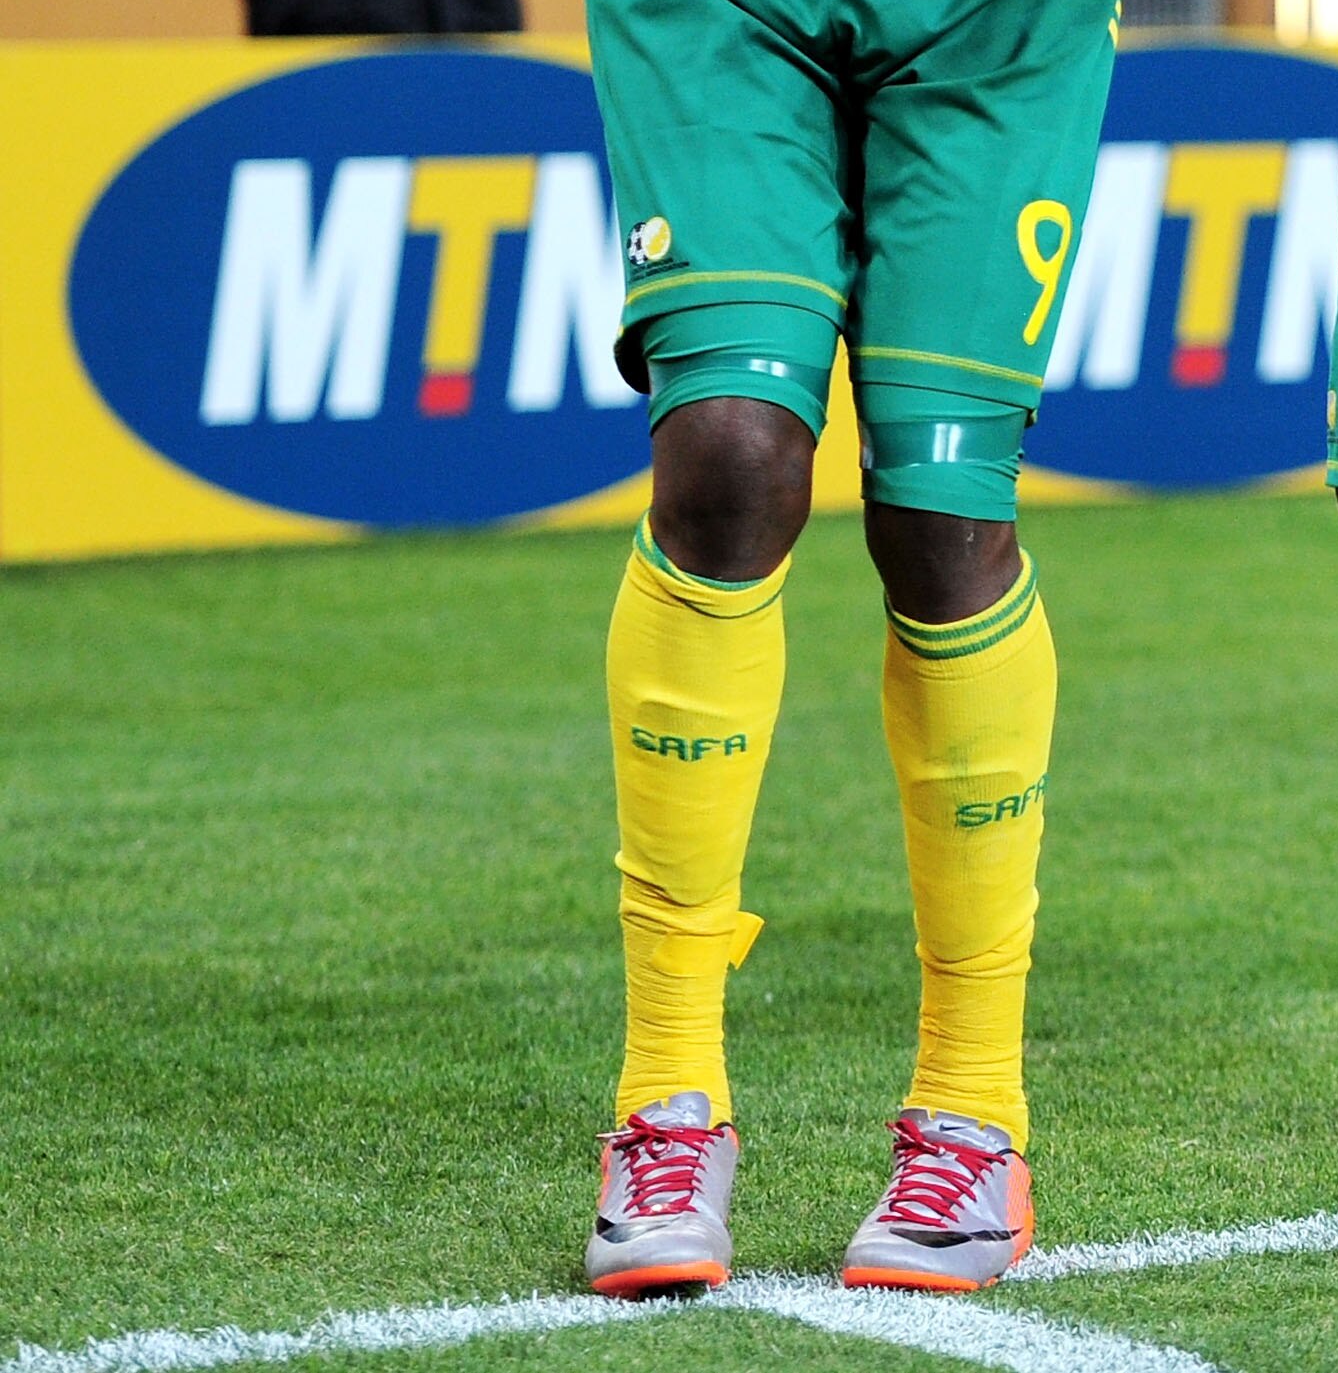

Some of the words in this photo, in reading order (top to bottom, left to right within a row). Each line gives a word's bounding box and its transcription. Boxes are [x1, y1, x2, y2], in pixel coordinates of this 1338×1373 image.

[199, 151, 644, 427] MTN
[1017, 199, 1073, 347] 9
[631, 726, 747, 762] SAFA
[956, 772, 1051, 828] SAFA
